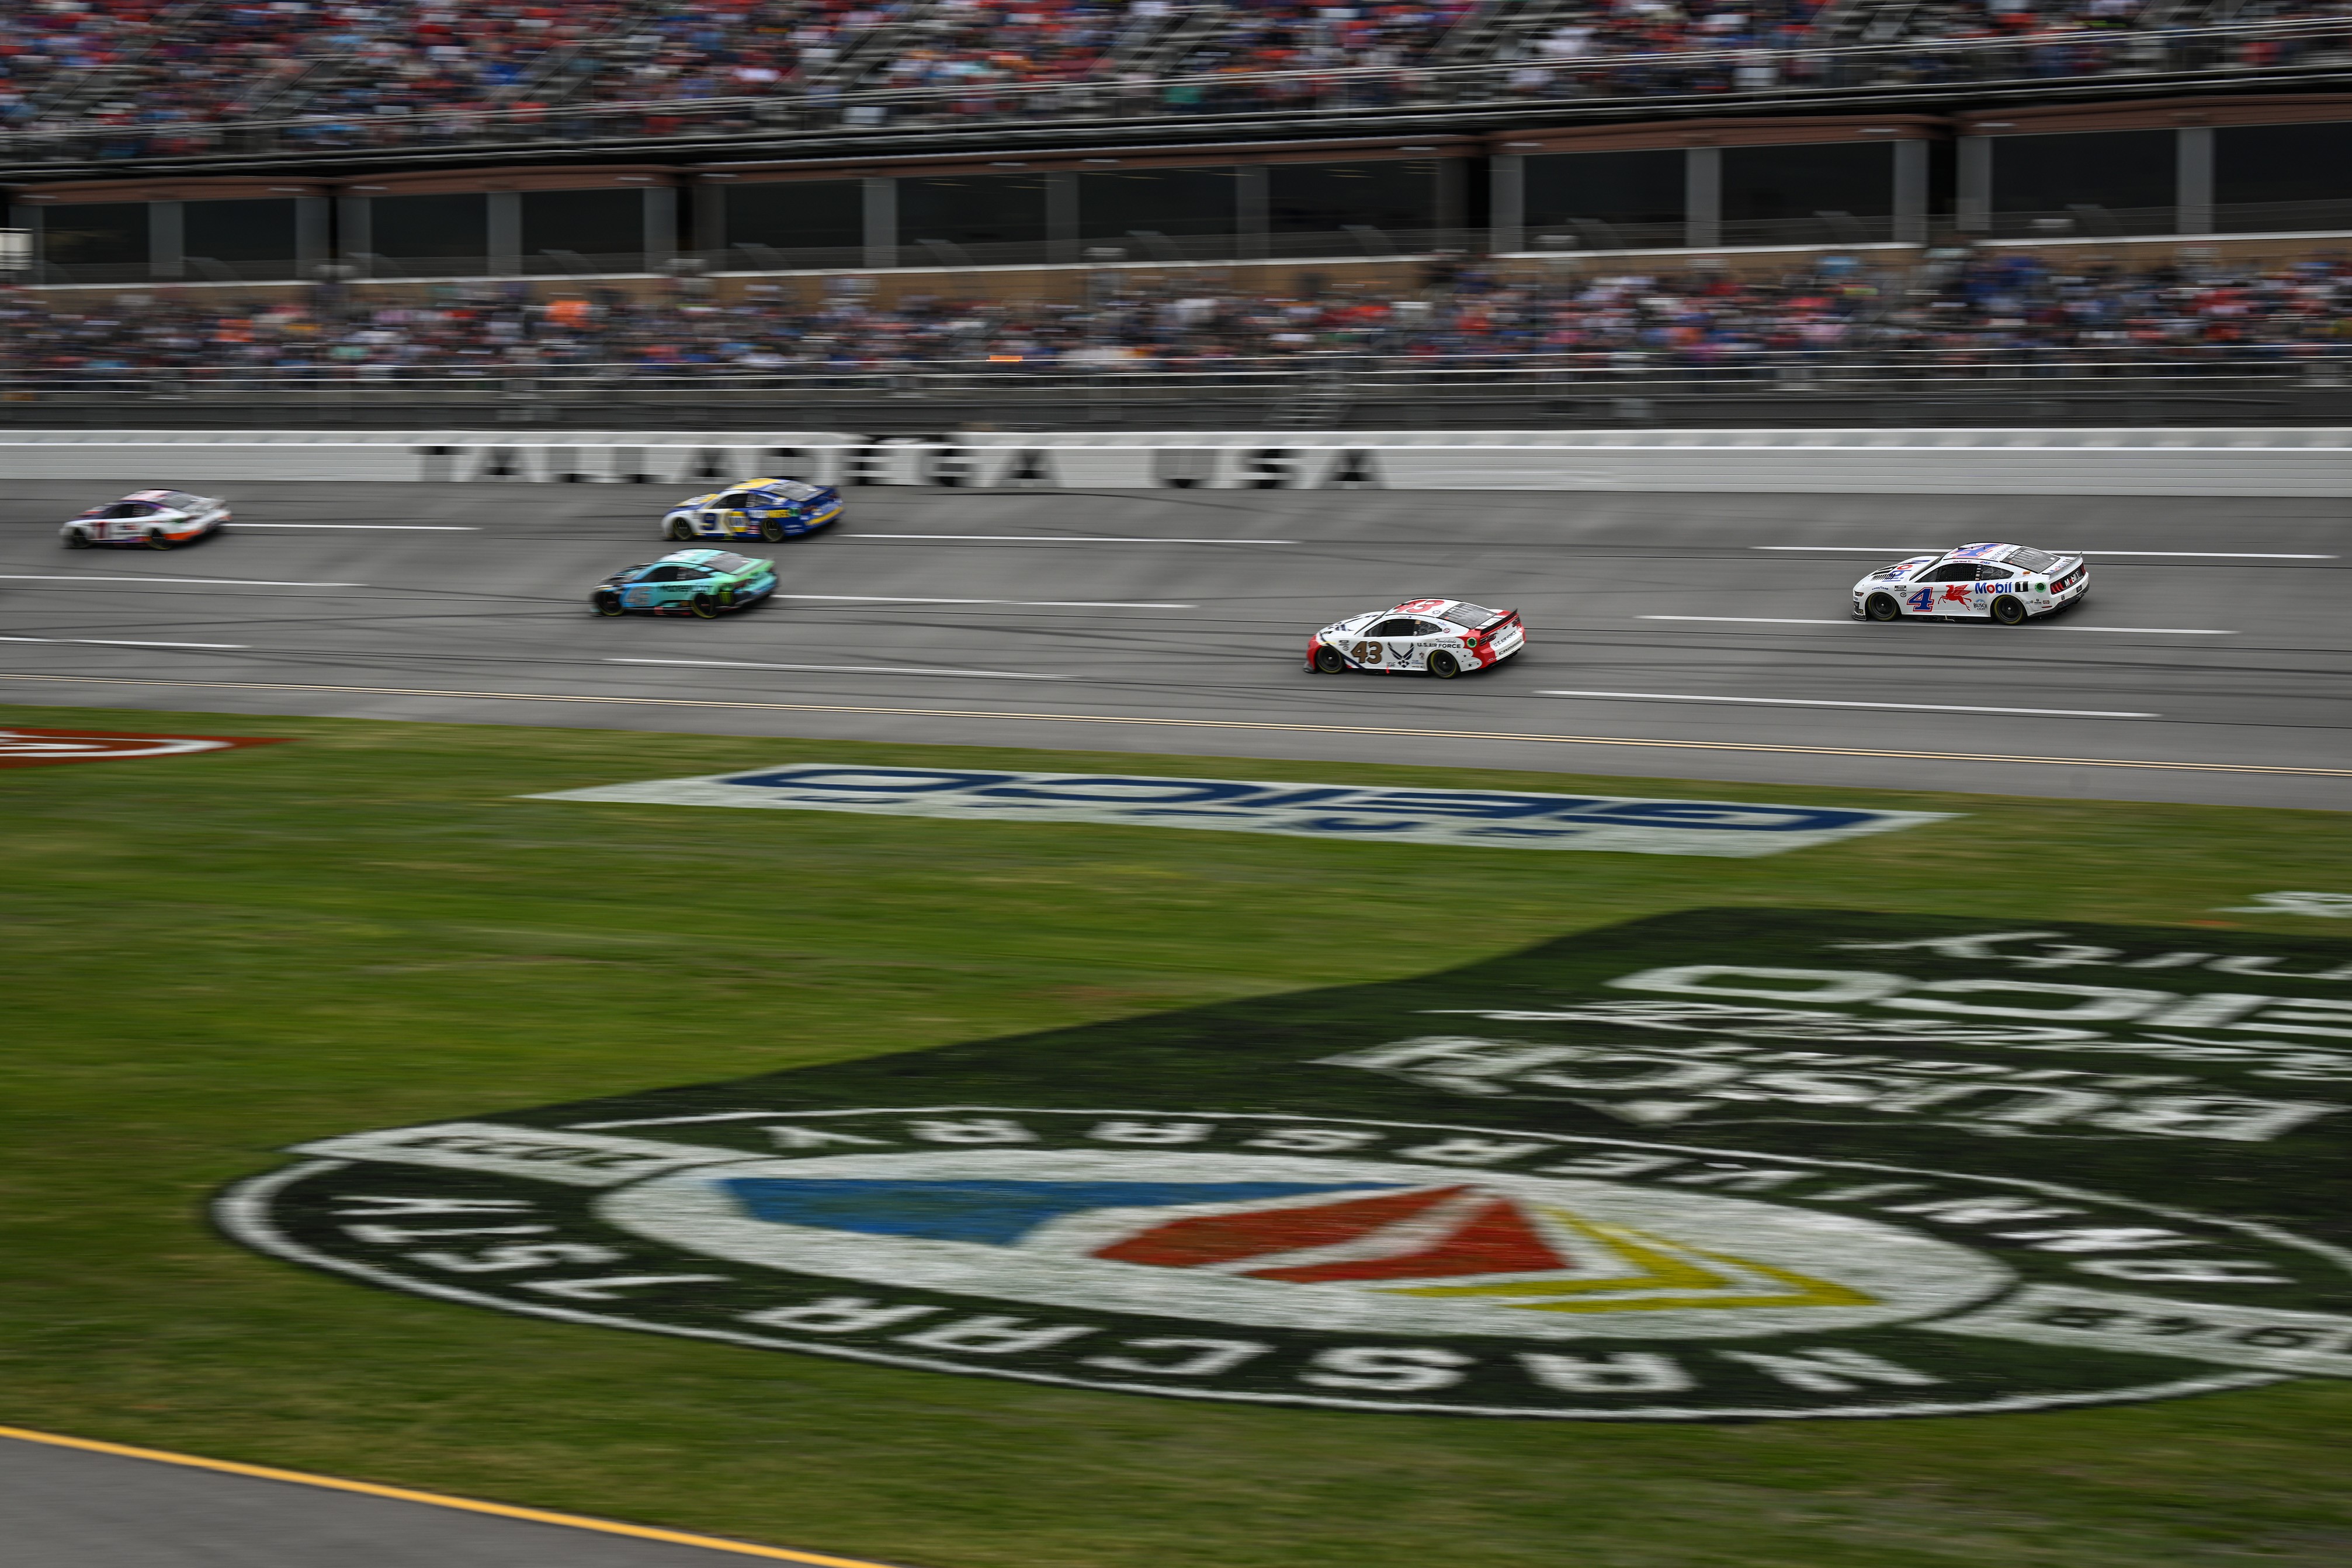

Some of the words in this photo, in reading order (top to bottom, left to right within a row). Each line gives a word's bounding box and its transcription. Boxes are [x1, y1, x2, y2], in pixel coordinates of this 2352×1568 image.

[413, 445, 1060, 488] TALLADEGA
[1155, 448, 1386, 490] USA
[1907, 587, 1934, 612] 4
[1975, 582, 2013, 594] Mobil
[2064, 573, 2077, 587] Mobil
[1350, 641, 1383, 664] 43
[716, 769, 1885, 832] GEICO
[1306, 1036, 2352, 1141] BUSCH
[754, 1119, 2294, 1284] ANNIVERSARY
[328, 1196, 728, 1299] 75TH
[737, 1297, 1944, 1394] NASCAR
